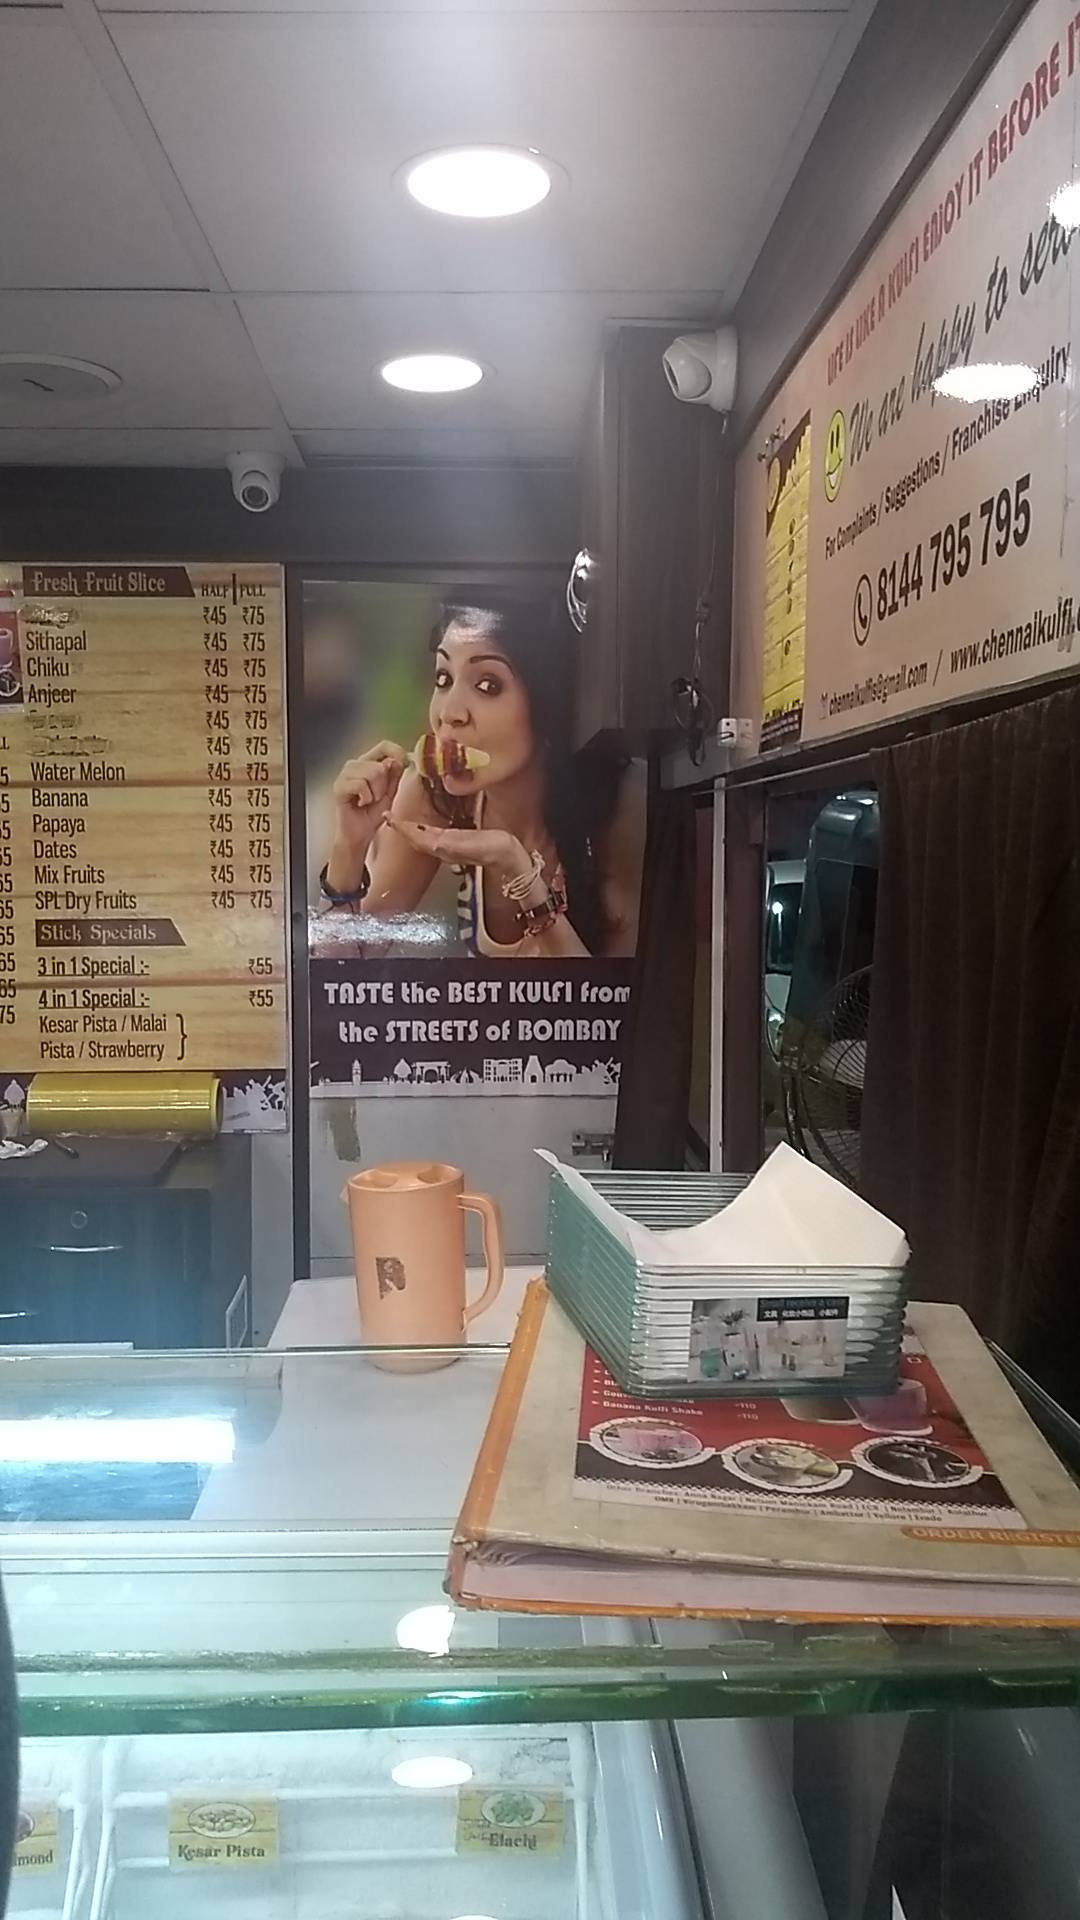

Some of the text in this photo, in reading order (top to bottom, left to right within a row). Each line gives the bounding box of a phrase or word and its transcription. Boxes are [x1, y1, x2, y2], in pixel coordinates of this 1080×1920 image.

[968, 148, 983, 205] IT
[988, 41, 1060, 180] BEFORE
[878, 376, 905, 437] are
[985, 255, 1008, 334] to
[826, 536, 836, 560] For
[837, 503, 877, 551] Complaints
[885, 451, 940, 513] Suggestions
[951, 398, 1010, 461] Franchise
[877, 473, 1031, 621] 8144 795 795
[32, 571, 266, 598] Fresh Fruit Slice HALF FULL
[25, 630, 87, 655] Sithapal
[27, 657, 70, 677] Chiku
[28, 684, 77, 708] Anjeer
[31, 762, 76, 781] Water
[80, 761, 125, 781] Melon
[32, 788, 88, 807] Banana
[33, 813, 85, 838] Papaya
[34, 839, 77, 859] Dates
[34, 865, 59, 884] Mix
[63, 864, 105, 884] Fruits
[35, 891, 61, 910] SPL
[65, 890, 91, 915] Dry
[96, 890, 137, 910] Fruits
[40, 924, 156, 944] Stick Specials
[38, 957, 47, 975] 3
[51, 956, 66, 975] in
[70, 957, 77, 974] 1
[81, 956, 136, 979] Special
[38, 990, 48, 1008] 4
[52, 989, 66, 1007] in
[70, 990, 77, 1007] 1
[82, 988, 136, 1011] Special
[324, 981, 630, 1004] TASTE the BEST KULFI from
[39, 1016, 78, 1033] Kesar
[83, 1014, 117, 1033] Pista
[131, 1013, 167, 1032] Malai
[339, 1019, 622, 1043] the STREETS of BOMBAY
[40, 1041, 75, 1059] Pista
[88, 1040, 165, 1061] Strawberry
[912, 1526, 985, 1541] ORDER
[178, 1843, 265, 1861] Kesar Pista
[489, 1832, 537, 1850] Elachi
[15, 1850, 53, 1867] mond
